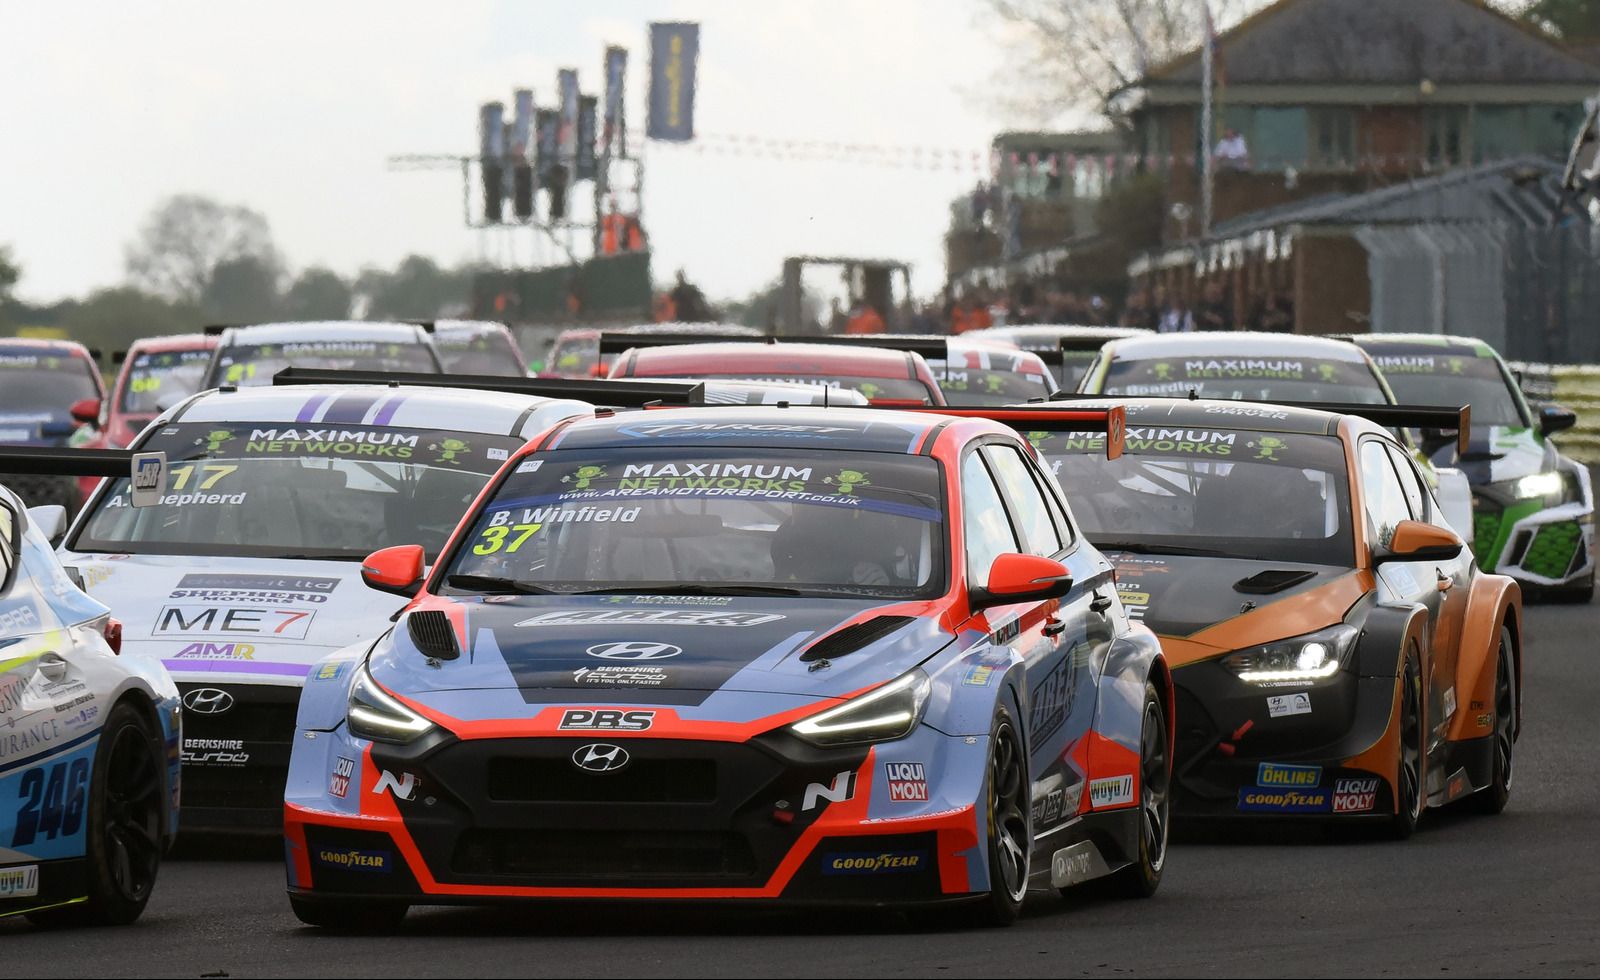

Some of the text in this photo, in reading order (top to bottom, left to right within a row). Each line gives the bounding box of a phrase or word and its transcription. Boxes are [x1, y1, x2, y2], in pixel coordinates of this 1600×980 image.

[1185, 359, 1303, 372] MAXIMUM
[642, 423, 857, 434] TARGET
[249, 429, 419, 447] MAXIMUM
[245, 441, 412, 458] NETWORKS
[1065, 439, 1231, 456] NEWORKS
[170, 465, 239, 490] 17
[622, 463, 812, 481] MAXIMUM
[618, 477, 805, 492] NETWORKS
[489, 506, 642, 527] B. Winfield
[472, 524, 542, 556] 37
[168, 590, 328, 604] SHEPHERD
[203, 596, 294, 604] MOTORS
[160, 608, 310, 635] ME7
[174, 642, 256, 661] AMR
[559, 709, 654, 730] PBS
[184, 738, 244, 750] BERKSHIRE
[887, 763, 925, 781] LIQUI
[1263, 765, 1316, 784] ÖHLINS
[890, 782, 928, 799] MOLY
[1336, 780, 1378, 793] LIQUI
[11, 757, 90, 848] 246
[1245, 792, 1325, 807] GOODYEAR
[1333, 793, 1374, 811] MOLY
[320, 850, 384, 868] GOODYEAR
[832, 853, 919, 871] GOODYEAR
